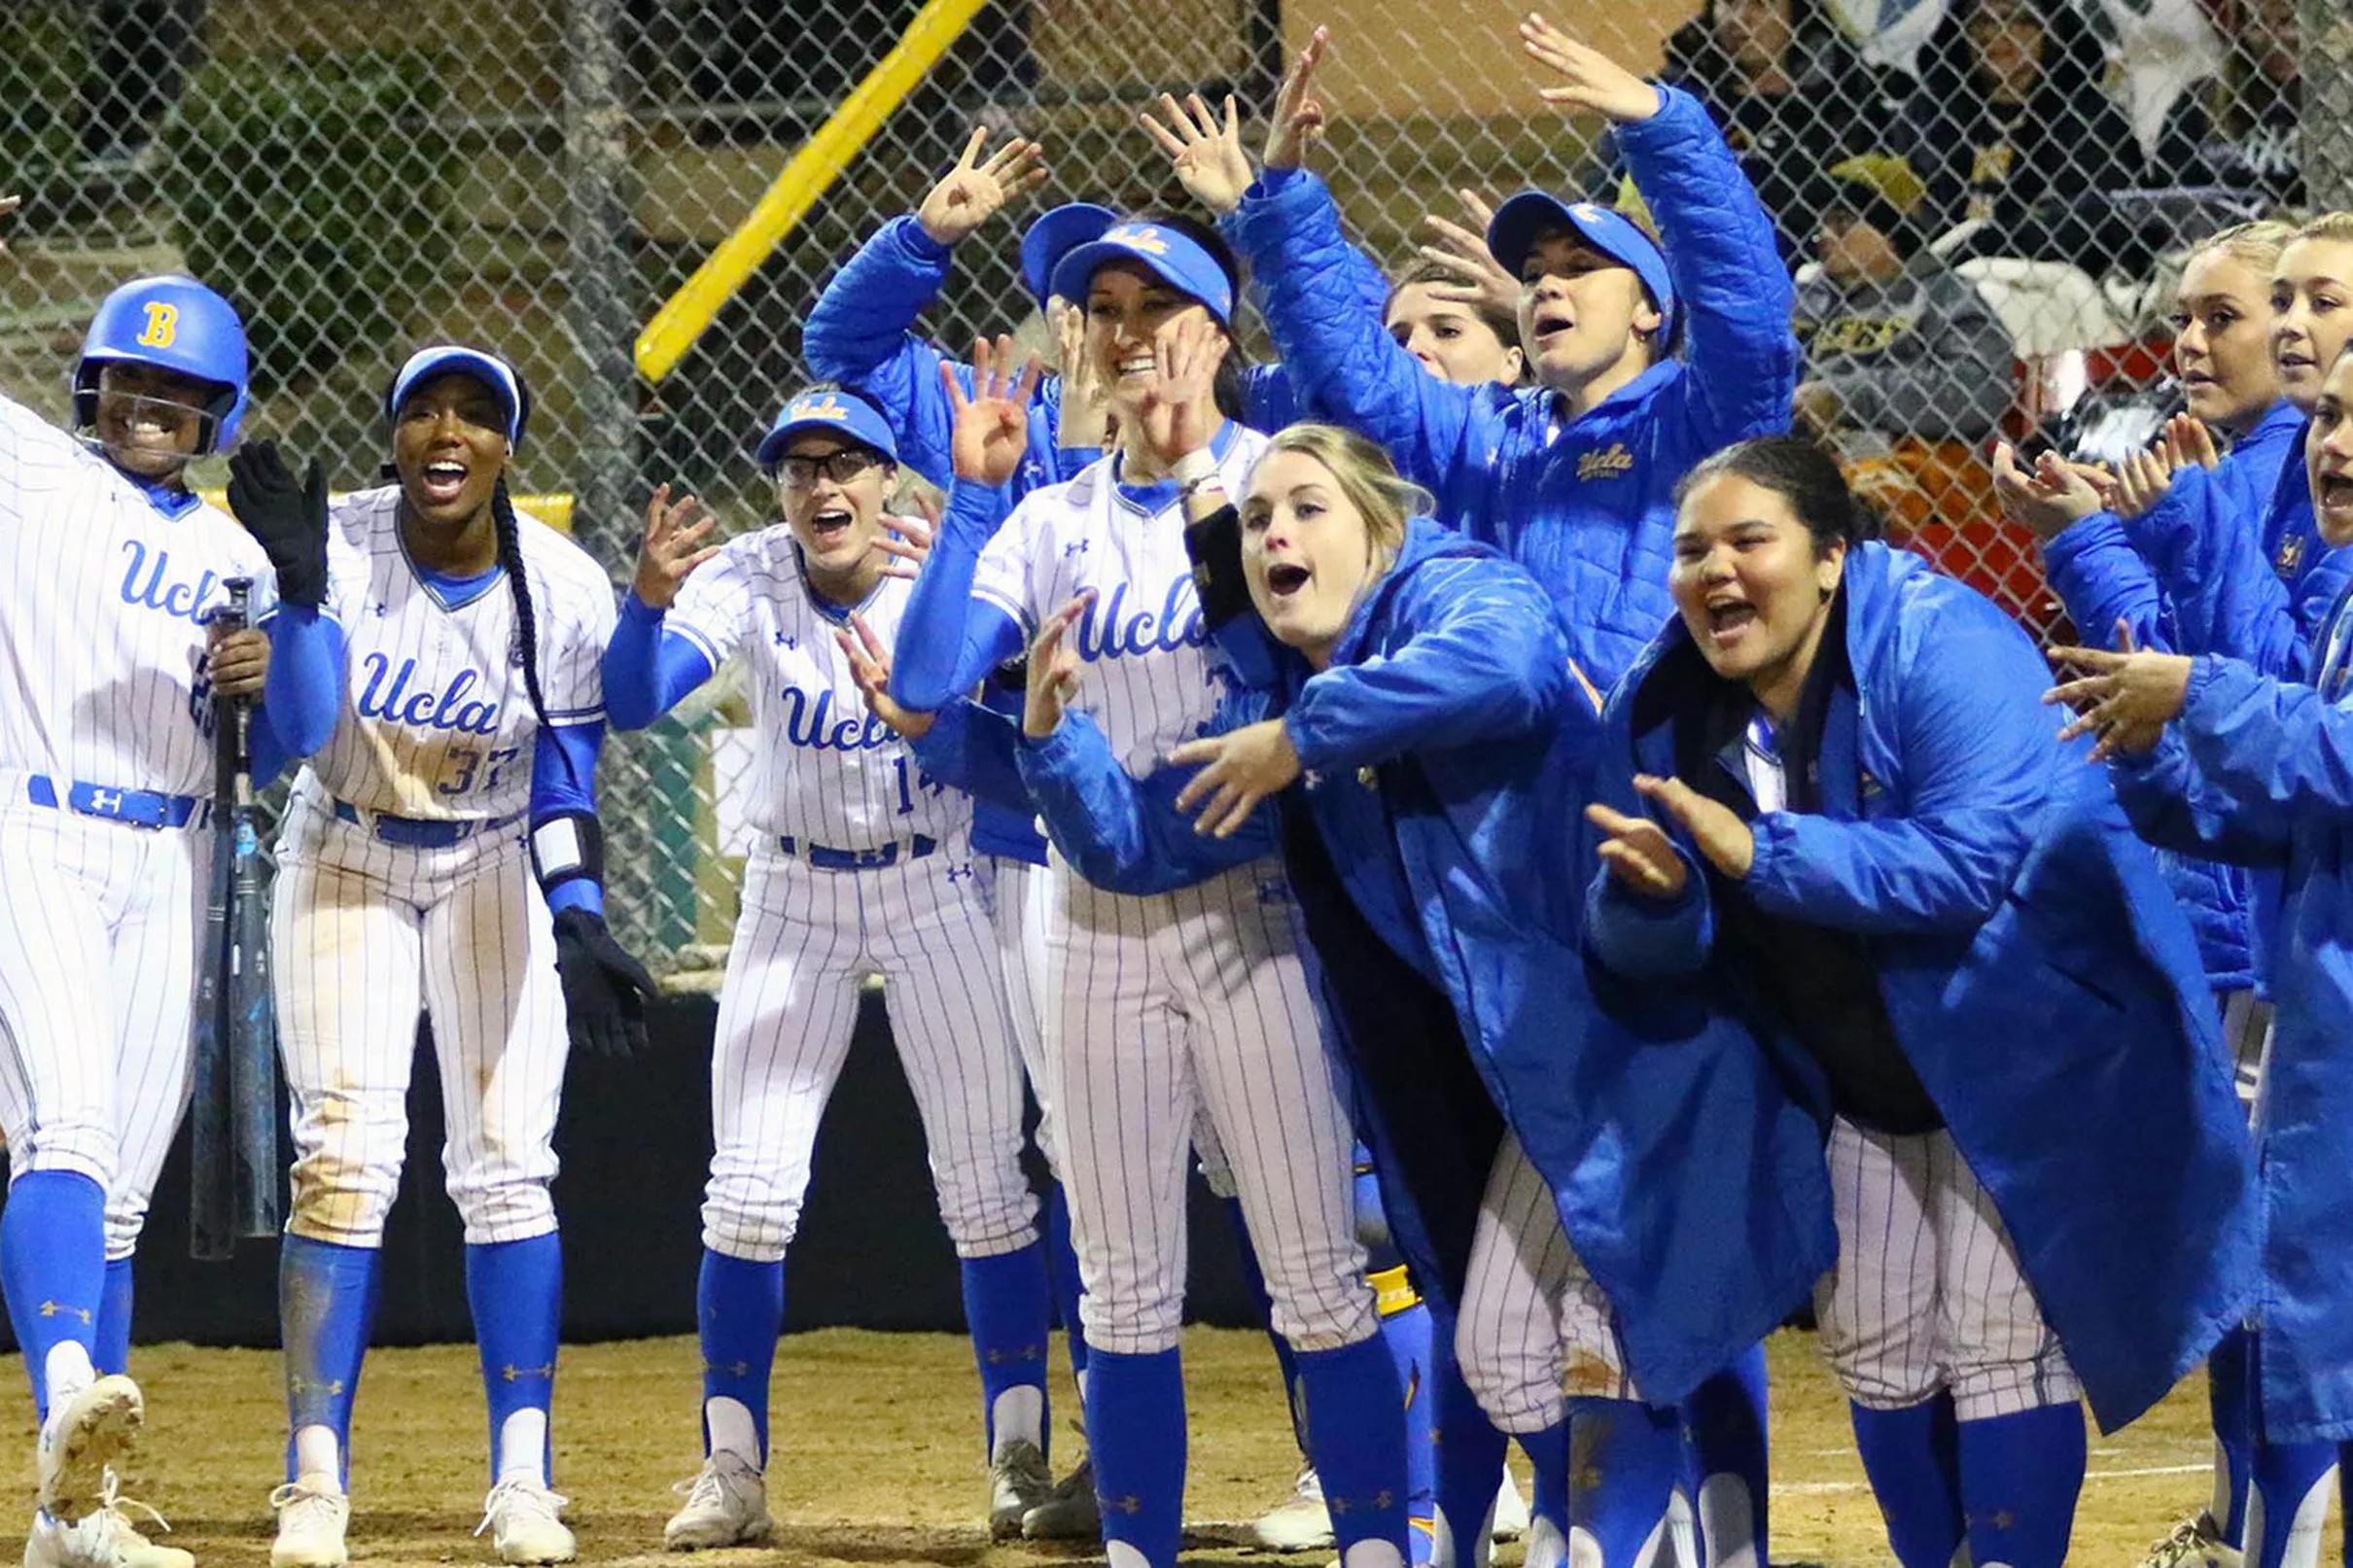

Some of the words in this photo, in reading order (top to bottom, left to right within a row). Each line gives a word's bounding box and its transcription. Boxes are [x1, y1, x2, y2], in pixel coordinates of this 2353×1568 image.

[136, 300, 179, 349] B
[120, 539, 220, 627] Ucl
[359, 651, 499, 736] Ucla
[438, 745, 520, 796] 37
